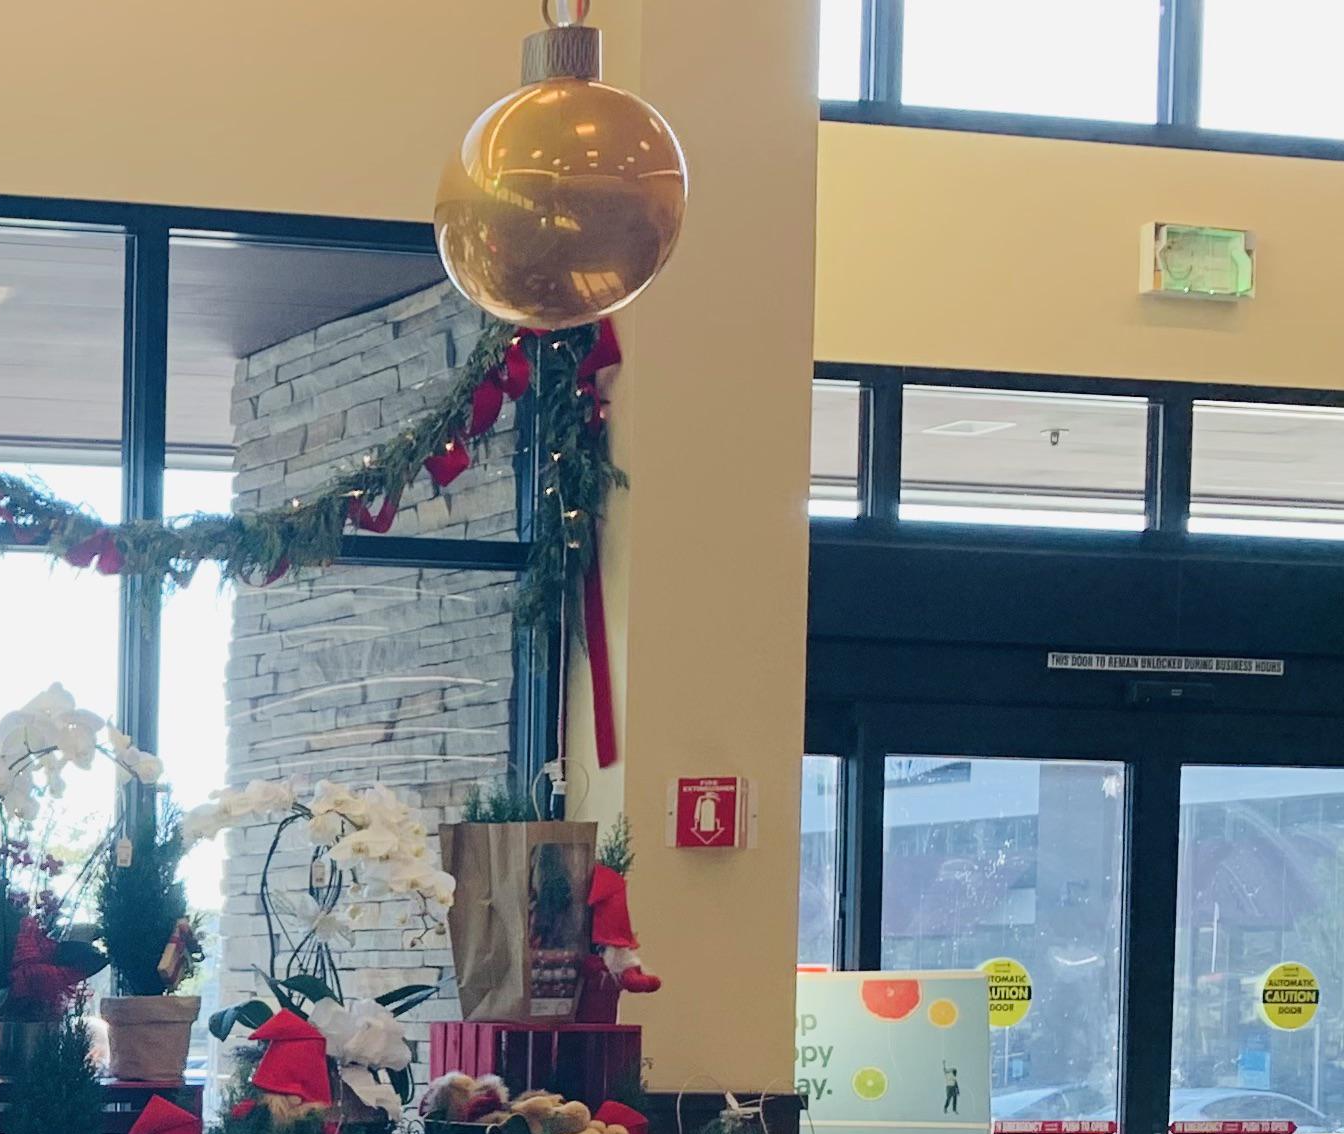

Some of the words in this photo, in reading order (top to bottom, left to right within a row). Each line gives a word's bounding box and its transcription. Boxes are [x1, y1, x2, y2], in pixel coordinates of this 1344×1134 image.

[1051, 654, 1069, 666] THIS
[1071, 654, 1093, 667] DOOR
[1095, 655, 1105, 668] TO
[1108, 656, 1139, 668] REMAIN
[1141, 656, 1182, 670] UNLOCKED
[1184, 657, 1213, 670] DURING
[1215, 659, 1253, 672] BUSINESS
[1255, 659, 1282, 673] HOURS
[1268, 979, 1315, 987] AUTOMATIC
[1264, 991, 1316, 1002] CAUTION
[989, 1003, 1014, 1011] DOOR
[1278, 1006, 1302, 1014] DOOR
